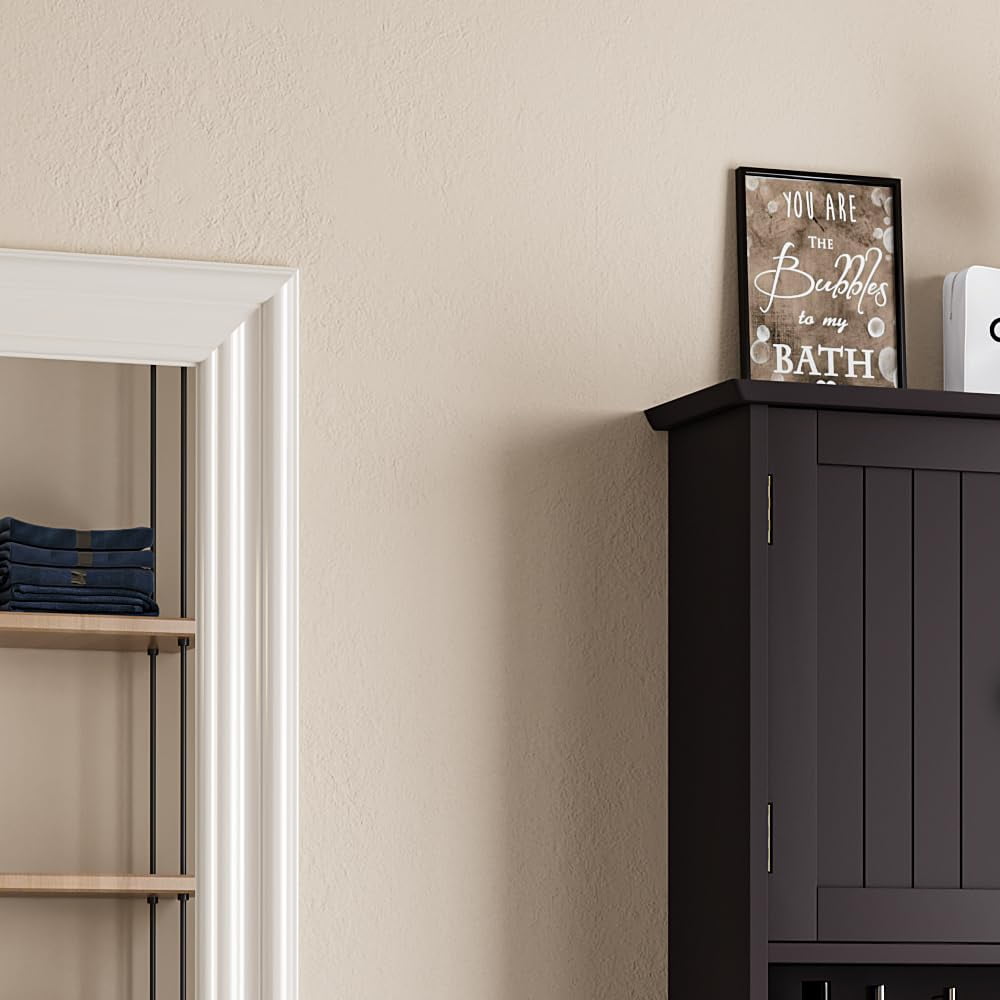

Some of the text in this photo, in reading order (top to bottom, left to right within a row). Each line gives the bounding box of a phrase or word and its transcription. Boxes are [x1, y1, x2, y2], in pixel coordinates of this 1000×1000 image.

[783, 191, 857, 222] YOU ARE
[808, 235, 834, 250] THE
[754, 242, 888, 315] Bubbles
[798, 310, 849, 333] to my
[772, 343, 875, 379] BATH
